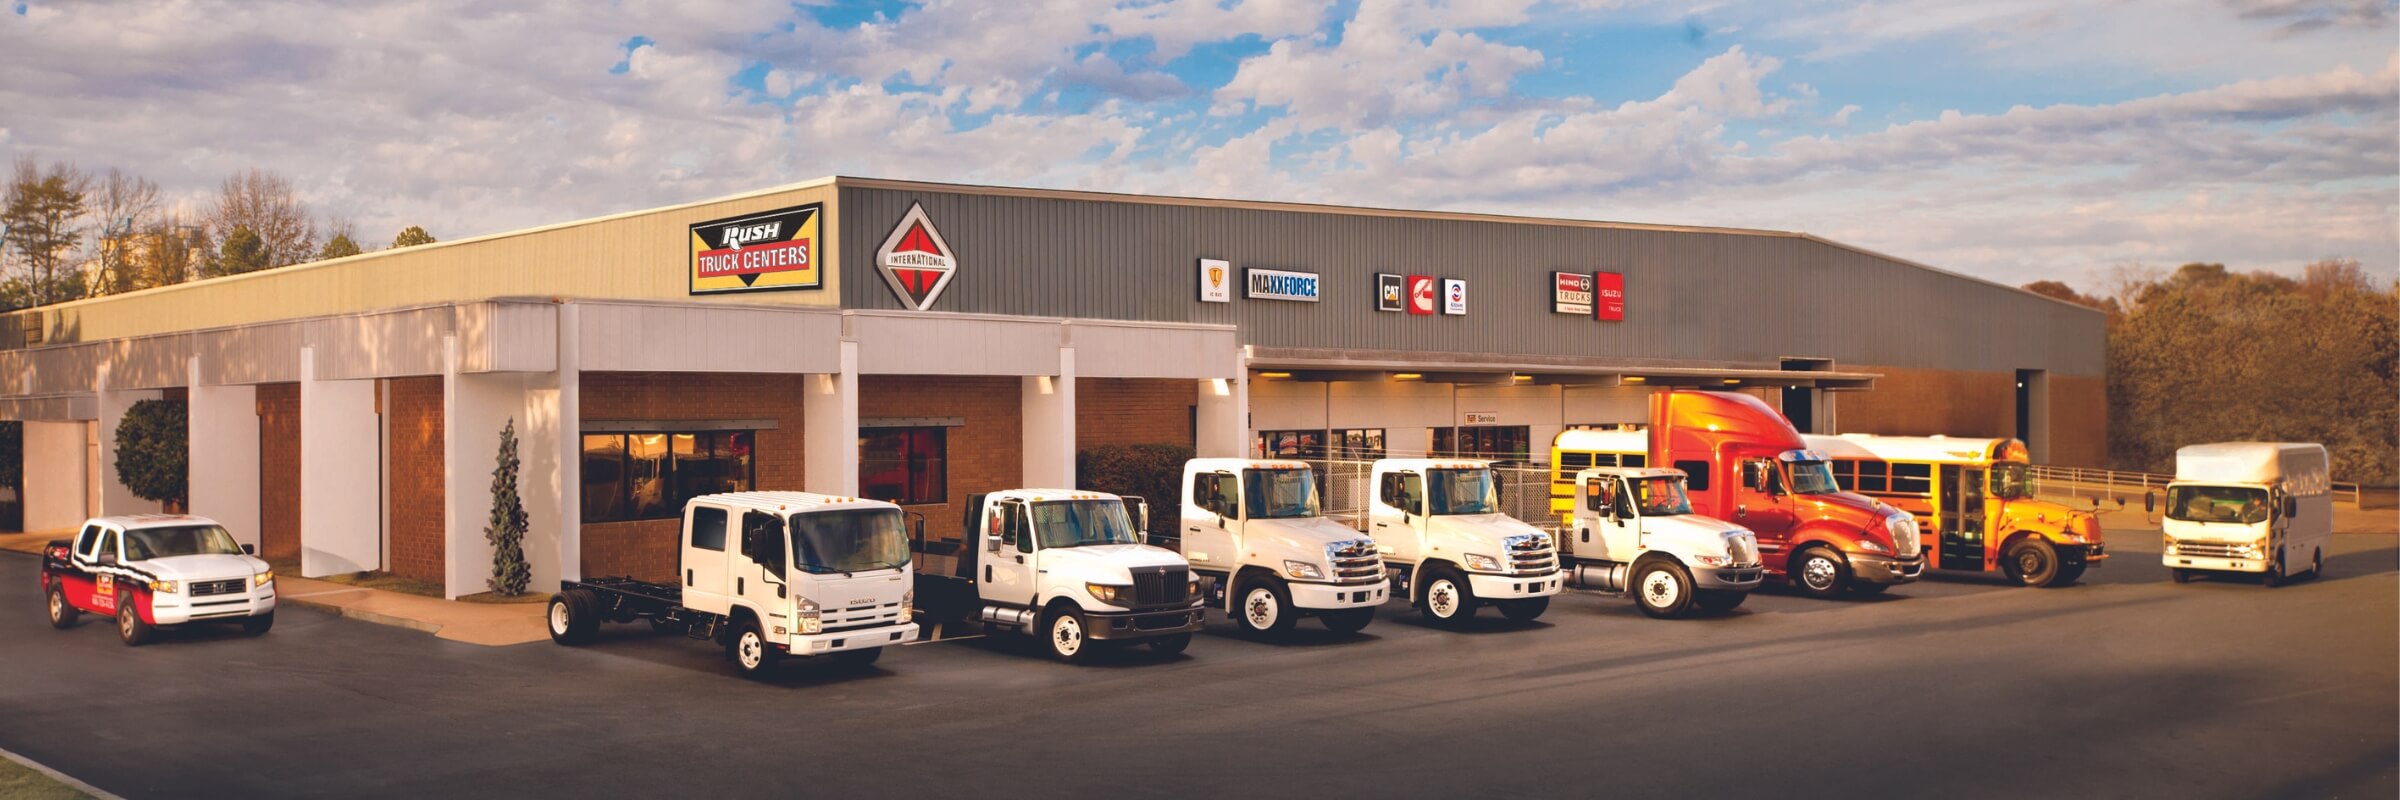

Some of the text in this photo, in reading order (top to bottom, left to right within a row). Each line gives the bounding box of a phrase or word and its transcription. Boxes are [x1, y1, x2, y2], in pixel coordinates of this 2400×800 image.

[722, 221, 781, 251] RUSH
[700, 245, 807, 273] TRUCK CENTERS
[891, 253, 946, 267] INTERNATIONAL
[1252, 274, 1316, 296] MAXXFORCE
[1560, 279, 1580, 287] HINO
[1384, 285, 1400, 301] CAT
[1560, 291, 1590, 302] TRUCKS
[1602, 289, 1621, 298] ISUZU
[1478, 414, 1496, 423] Service
